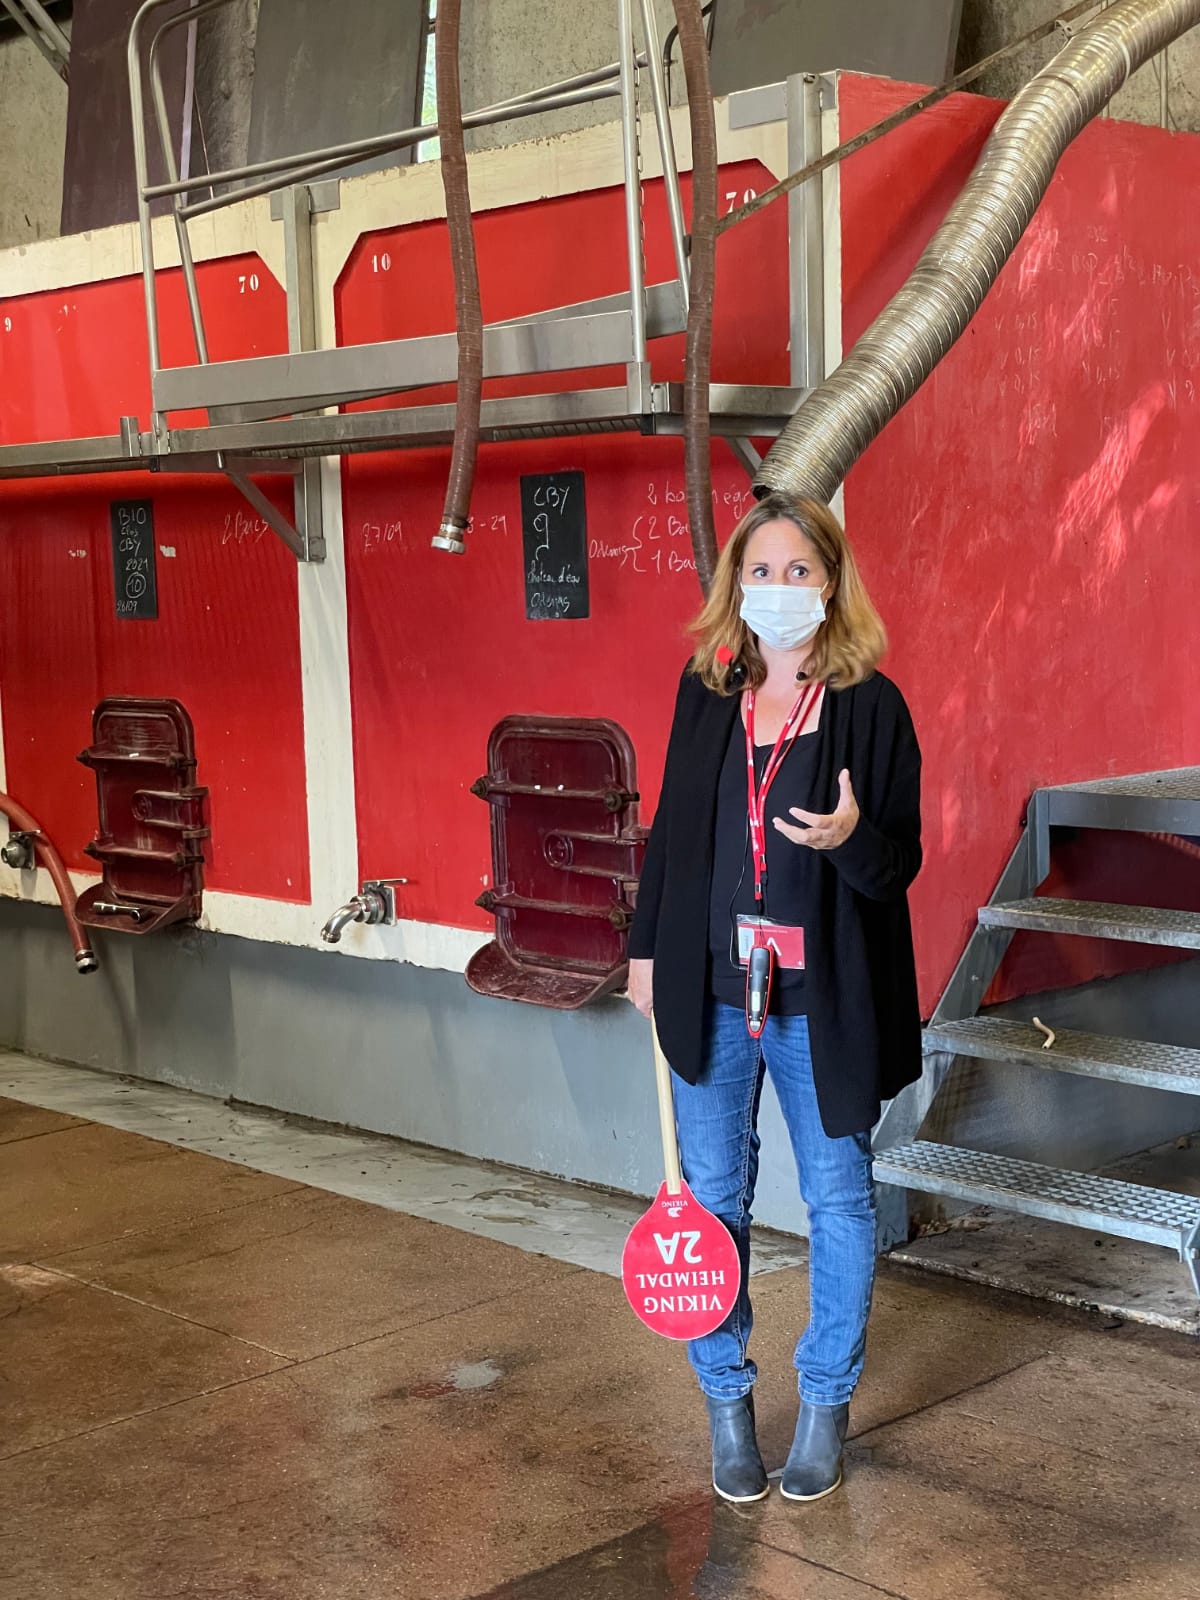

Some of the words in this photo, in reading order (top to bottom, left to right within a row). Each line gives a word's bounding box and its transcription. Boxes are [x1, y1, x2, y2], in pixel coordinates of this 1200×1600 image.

[371, 252, 392, 272] 10
[238, 273, 260, 294] 70
[4, 316, 12, 333] 9
[661, 1200, 688, 1208] VIKING
[653, 1230, 702, 1265] 2A
[636, 1270, 725, 1289] HEIMDAL
[643, 1294, 723, 1313] VIKING
